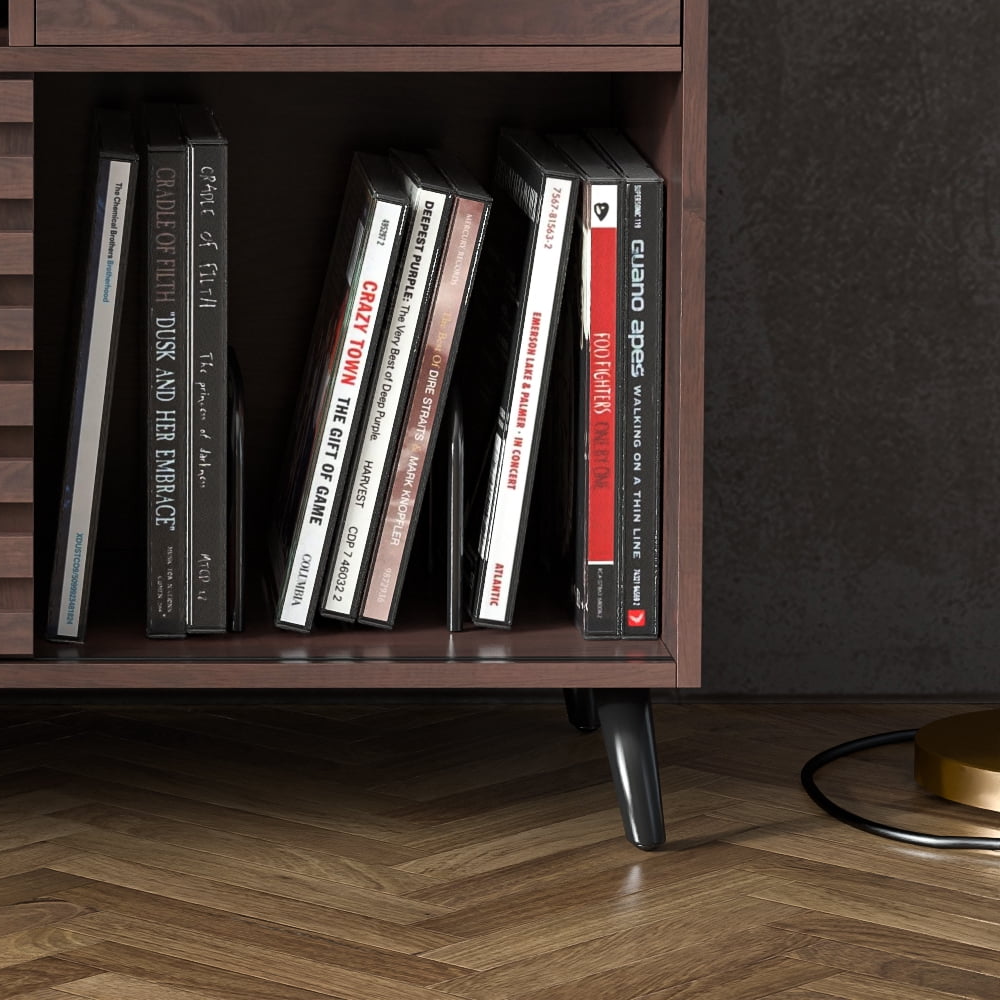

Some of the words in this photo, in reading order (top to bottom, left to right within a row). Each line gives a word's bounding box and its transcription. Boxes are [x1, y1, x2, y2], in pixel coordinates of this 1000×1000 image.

[114, 182, 123, 195] The
[156, 167, 176, 229] CRADLE
[200, 166, 218, 217] CRADLE
[111, 196, 121, 229] Chemical
[414, 200, 434, 252] DEEPEST
[544, 187, 562, 249] 7567-81563-2
[108, 230, 118, 259] Brothers
[156, 232, 176, 254] OF
[457, 214, 473, 250] MERCURY
[103, 260, 114, 303] Brotherhood
[156, 259, 176, 302] FILTH
[402, 254, 422, 302] PURPLE:
[450, 251, 465, 286] RECORDS
[199, 263, 218, 308] FILTH
[353, 281, 378, 334] CRAZY
[397, 304, 411, 322] The
[155, 311, 176, 362] "DUSK
[391, 325, 405, 346] Very
[434, 332, 448, 352] Best
[526, 311, 542, 356] EMERSON
[593, 332, 611, 358] FOO
[199, 352, 214, 374] The
[341, 339, 365, 386] TOWN
[387, 347, 400, 369] Best
[430, 354, 442, 367] Of
[523, 357, 535, 381] LAKE
[155, 368, 176, 402] AND
[384, 371, 394, 382] of
[425, 369, 439, 395] DIRE
[593, 361, 612, 415] FIGHTERS
[333, 397, 351, 424] THE
[376, 384, 391, 408] Deep
[516, 391, 530, 429] PALMER
[155, 410, 176, 441] HER
[414, 397, 432, 441] STRAITS
[633, 384, 642, 448] WALKING
[199, 429, 212, 440] of
[325, 428, 343, 460] GIFT
[411, 443, 421, 452] &
[513, 437, 523, 447] IN
[320, 463, 335, 482] OF
[403, 455, 419, 487] MARK
[506, 449, 521, 490] CONCERT
[633, 452, 642, 471] ON
[155, 449, 176, 531] EMBRACE"
[355, 460, 374, 509] HARVEST
[633, 476, 641, 485] A
[309, 485, 329, 526] GAME
[390, 489, 412, 546] KNOPFLER
[632, 490, 641, 523] THIN
[345, 526, 359, 549] CDP
[632, 527, 641, 560] LINE
[291, 553, 312, 606] COLUMBIA
[334, 559, 350, 593] 46032
[490, 563, 505, 607] ATLANTIC
